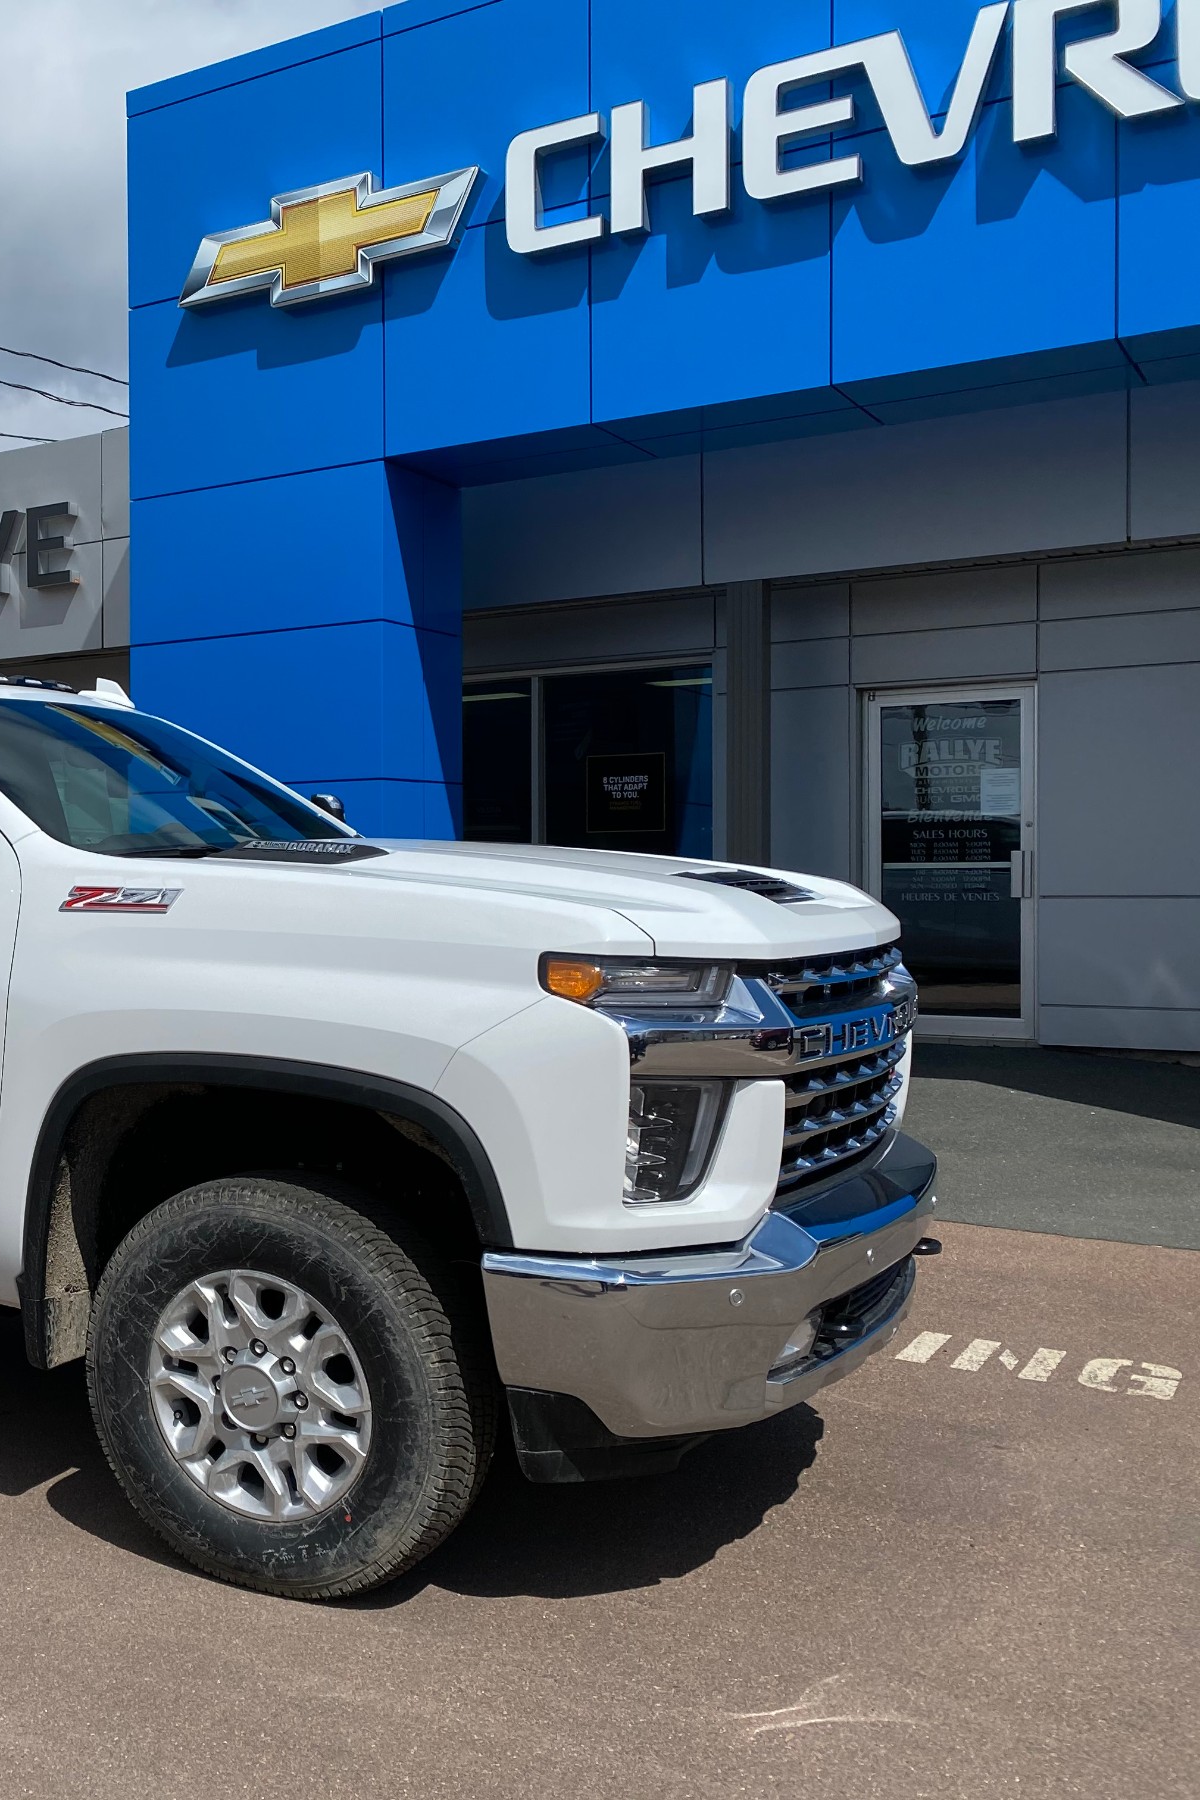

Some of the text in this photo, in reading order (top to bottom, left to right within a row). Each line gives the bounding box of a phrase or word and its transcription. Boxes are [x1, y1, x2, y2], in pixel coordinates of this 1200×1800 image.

[505, 0, 1200, 255] CHEVR
[913, 716, 987, 732] Welcome
[900, 739, 1002, 769] RALLYE
[603, 775, 649, 784] 8 CYLINDERS
[914, 785, 981, 794] CHEVROLE
[913, 828, 988, 839] SALES HOURS
[286, 842, 356, 854] DURAMAX
[58, 885, 185, 914] Z71
[901, 892, 1000, 902] HEURES DE VENTES
